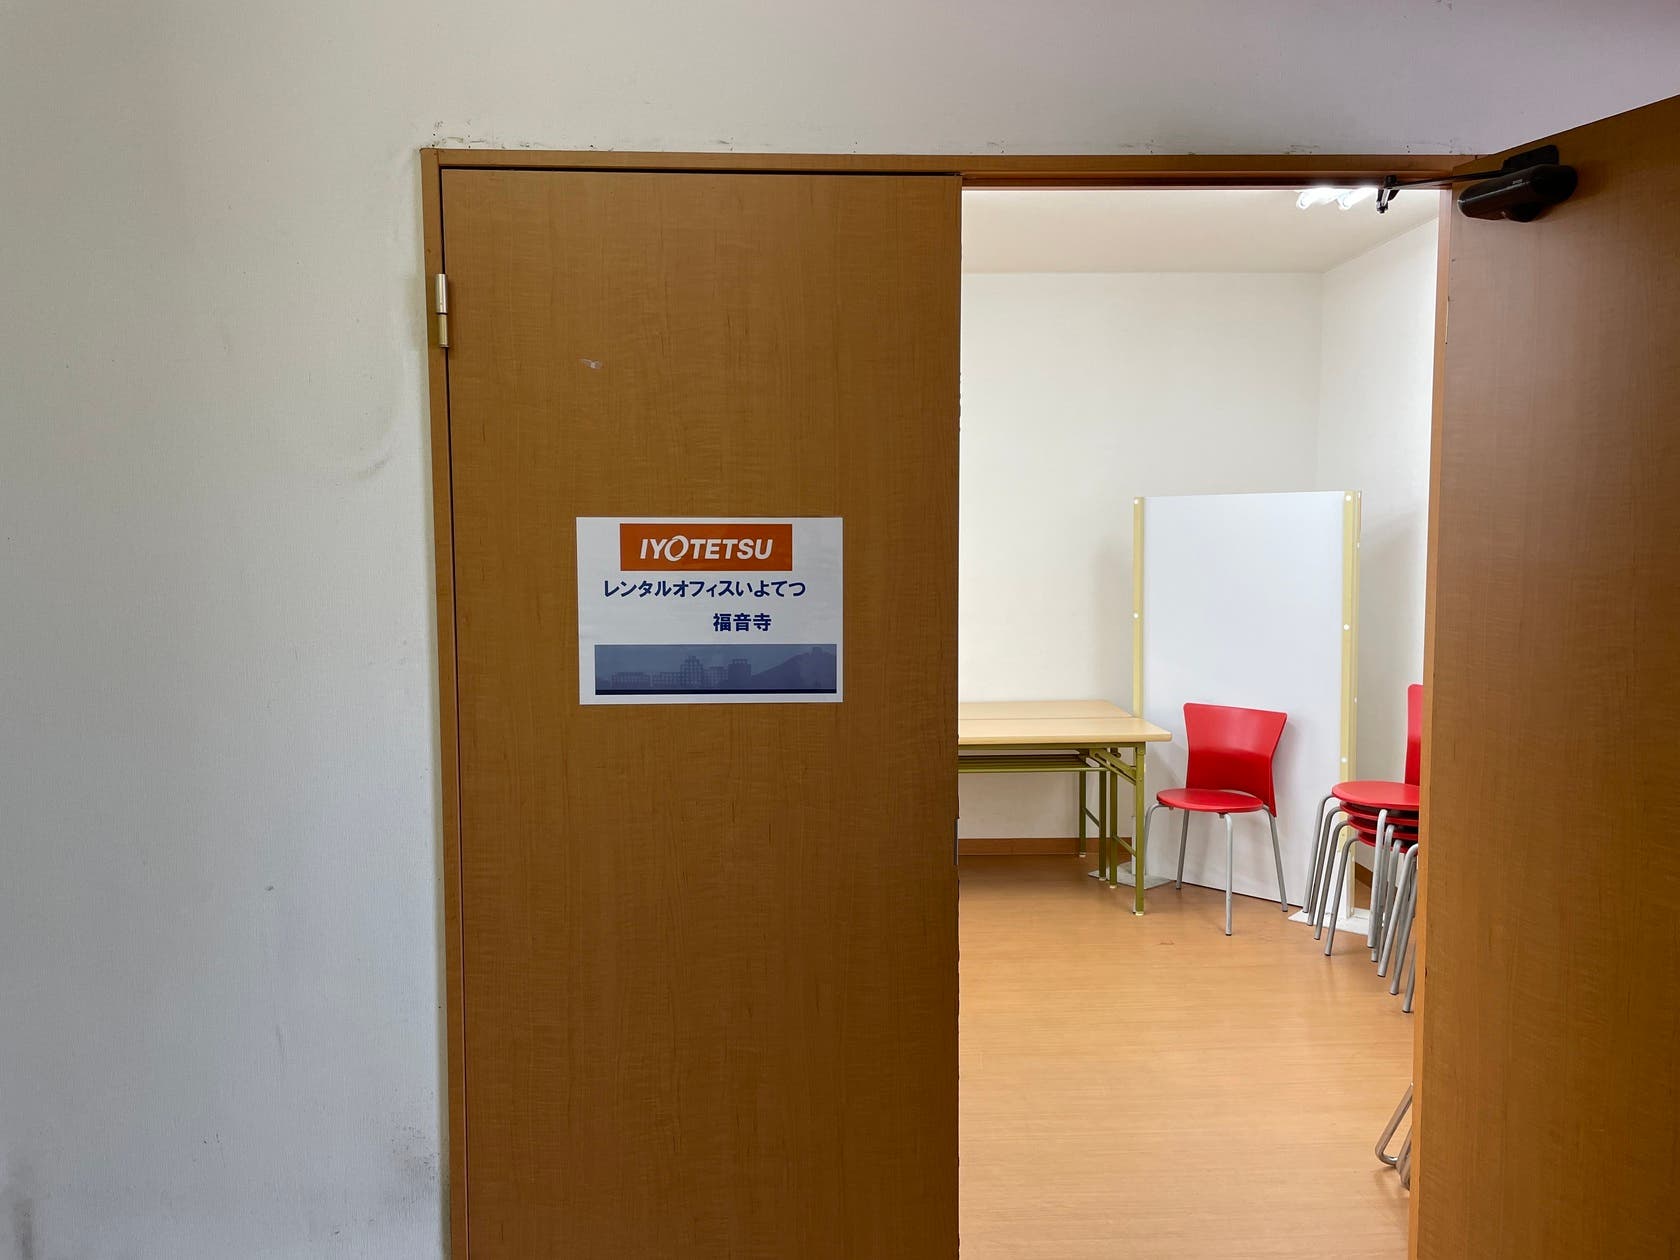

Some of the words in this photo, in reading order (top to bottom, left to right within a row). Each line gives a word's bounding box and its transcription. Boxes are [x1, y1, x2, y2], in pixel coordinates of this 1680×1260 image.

[640, 535, 773, 562] IYOTETSU
[604, 580, 806, 598] レンタルオフィスいよてつ
[713, 613, 772, 632] 福音寺
